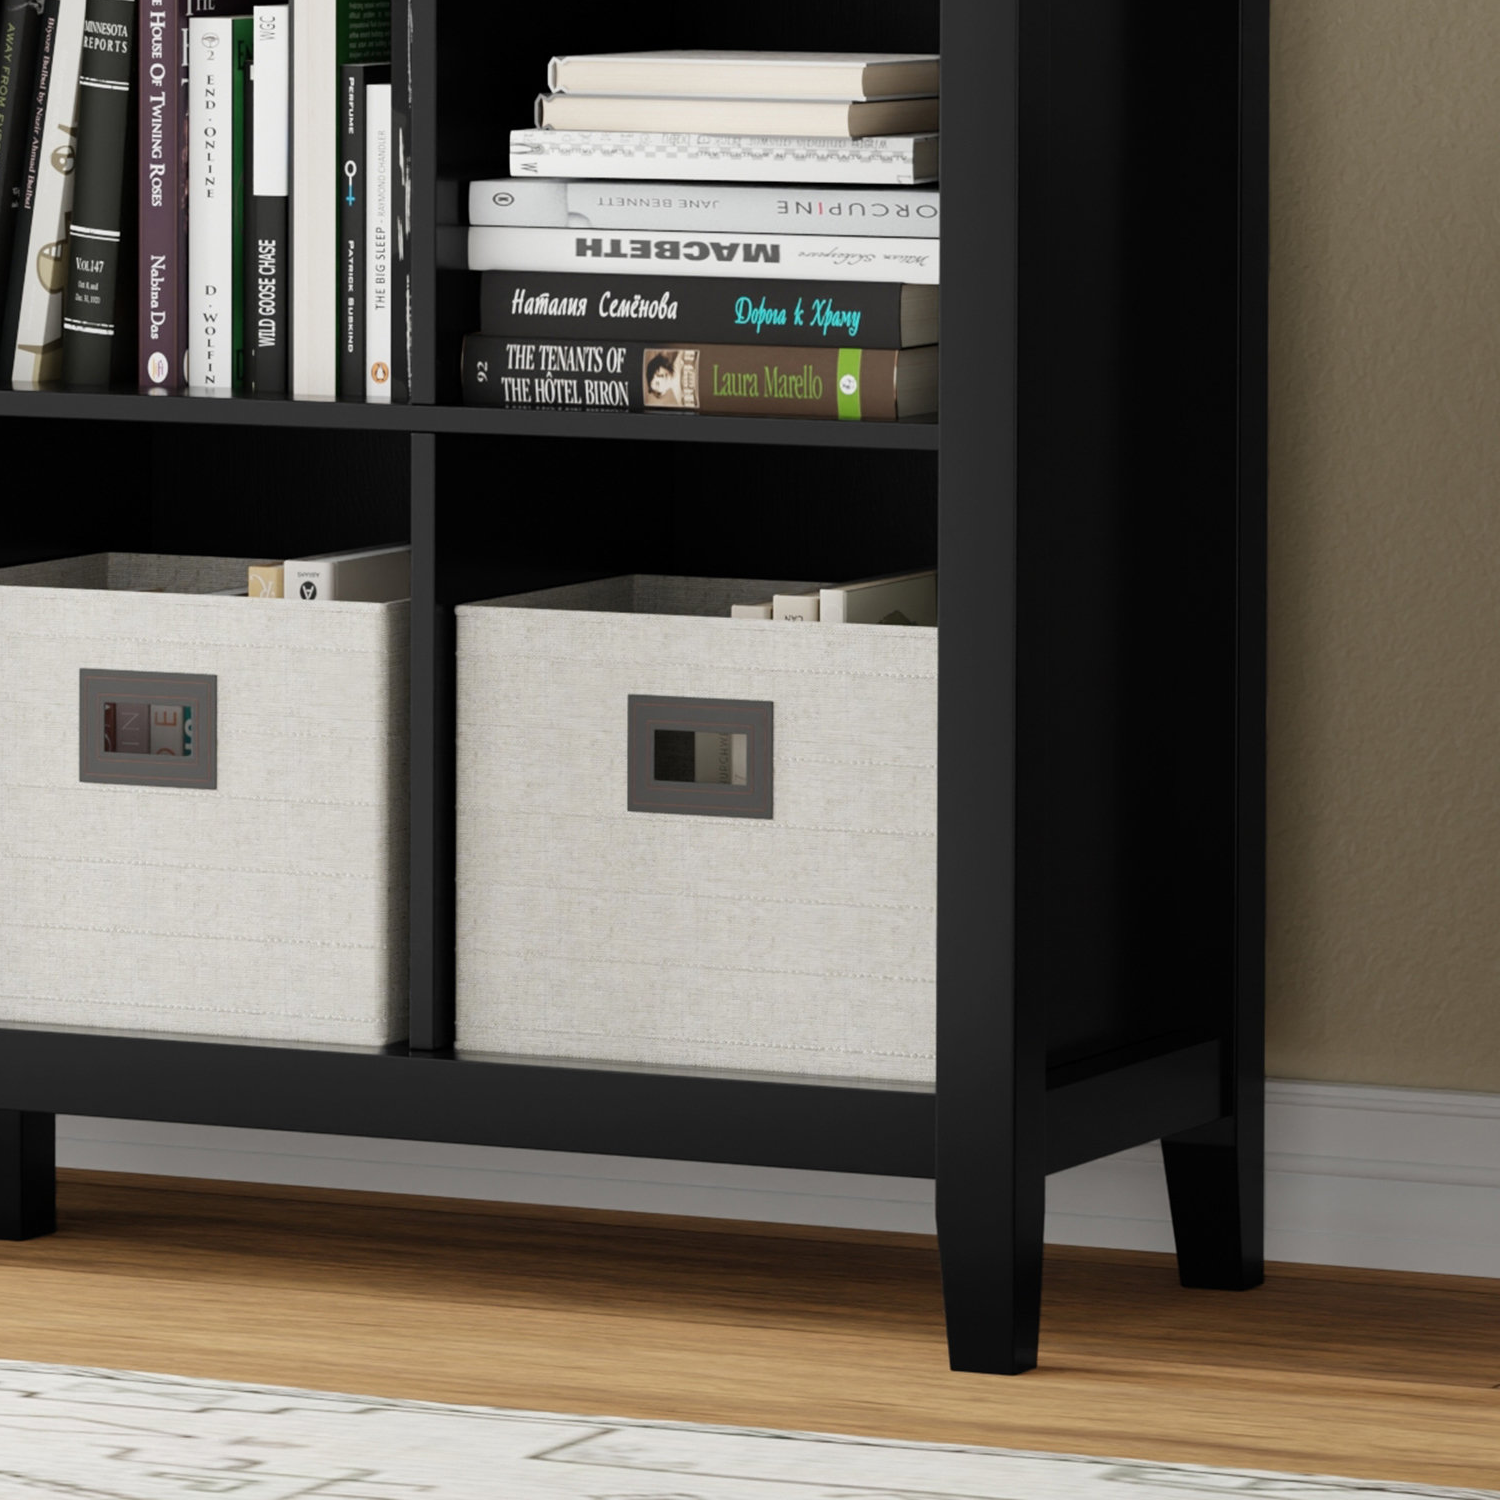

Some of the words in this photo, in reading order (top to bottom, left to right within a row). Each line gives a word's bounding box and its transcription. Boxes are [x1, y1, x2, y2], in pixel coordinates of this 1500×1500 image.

[3, 22, 16, 63] AWAY
[43, 17, 55, 53] Biyoze
[83, 35, 128, 54] REPORTS
[150, 11, 166, 59] HOUSE
[259, 15, 276, 42] WGC
[150, 62, 166, 87] OF
[36, 92, 47, 104] by
[33, 106, 45, 135] Nazir
[150, 91, 166, 159] TWINING
[27, 137, 41, 173] Ahmad
[377, 129, 387, 174] CHANDLER
[149, 163, 166, 207] ROSES
[377, 176, 387, 217] RAYMOND
[599, 196, 673, 208] BENNETT
[679, 197, 720, 210] JANE
[777, 199, 938, 219] ORCUPINE
[257, 239, 277, 276] CHASE
[375, 227, 386, 260] SLEEP
[575, 237, 781, 264] MACBETH
[150, 255, 166, 308] Nabina
[347, 240, 355, 293] PATRICK
[375, 268, 386, 285] BIG
[257, 278, 277, 316] GOOSE
[375, 288, 386, 311] THE
[511, 288, 588, 317] Наталия
[599, 290, 679, 320] Семёнова
[150, 311, 166, 340] Das
[257, 318, 277, 348] WILD
[347, 297, 355, 353] SUSKIND
[506, 343, 536, 370] THE
[539, 344, 604, 373] TENANTS
[606, 346, 627, 374] OF
[501, 376, 531, 402] THE
[534, 370, 583, 405] HÔTEL
[584, 378, 630, 407] BIRON
[712, 364, 760, 398] Laura
[764, 365, 823, 400] Marello
